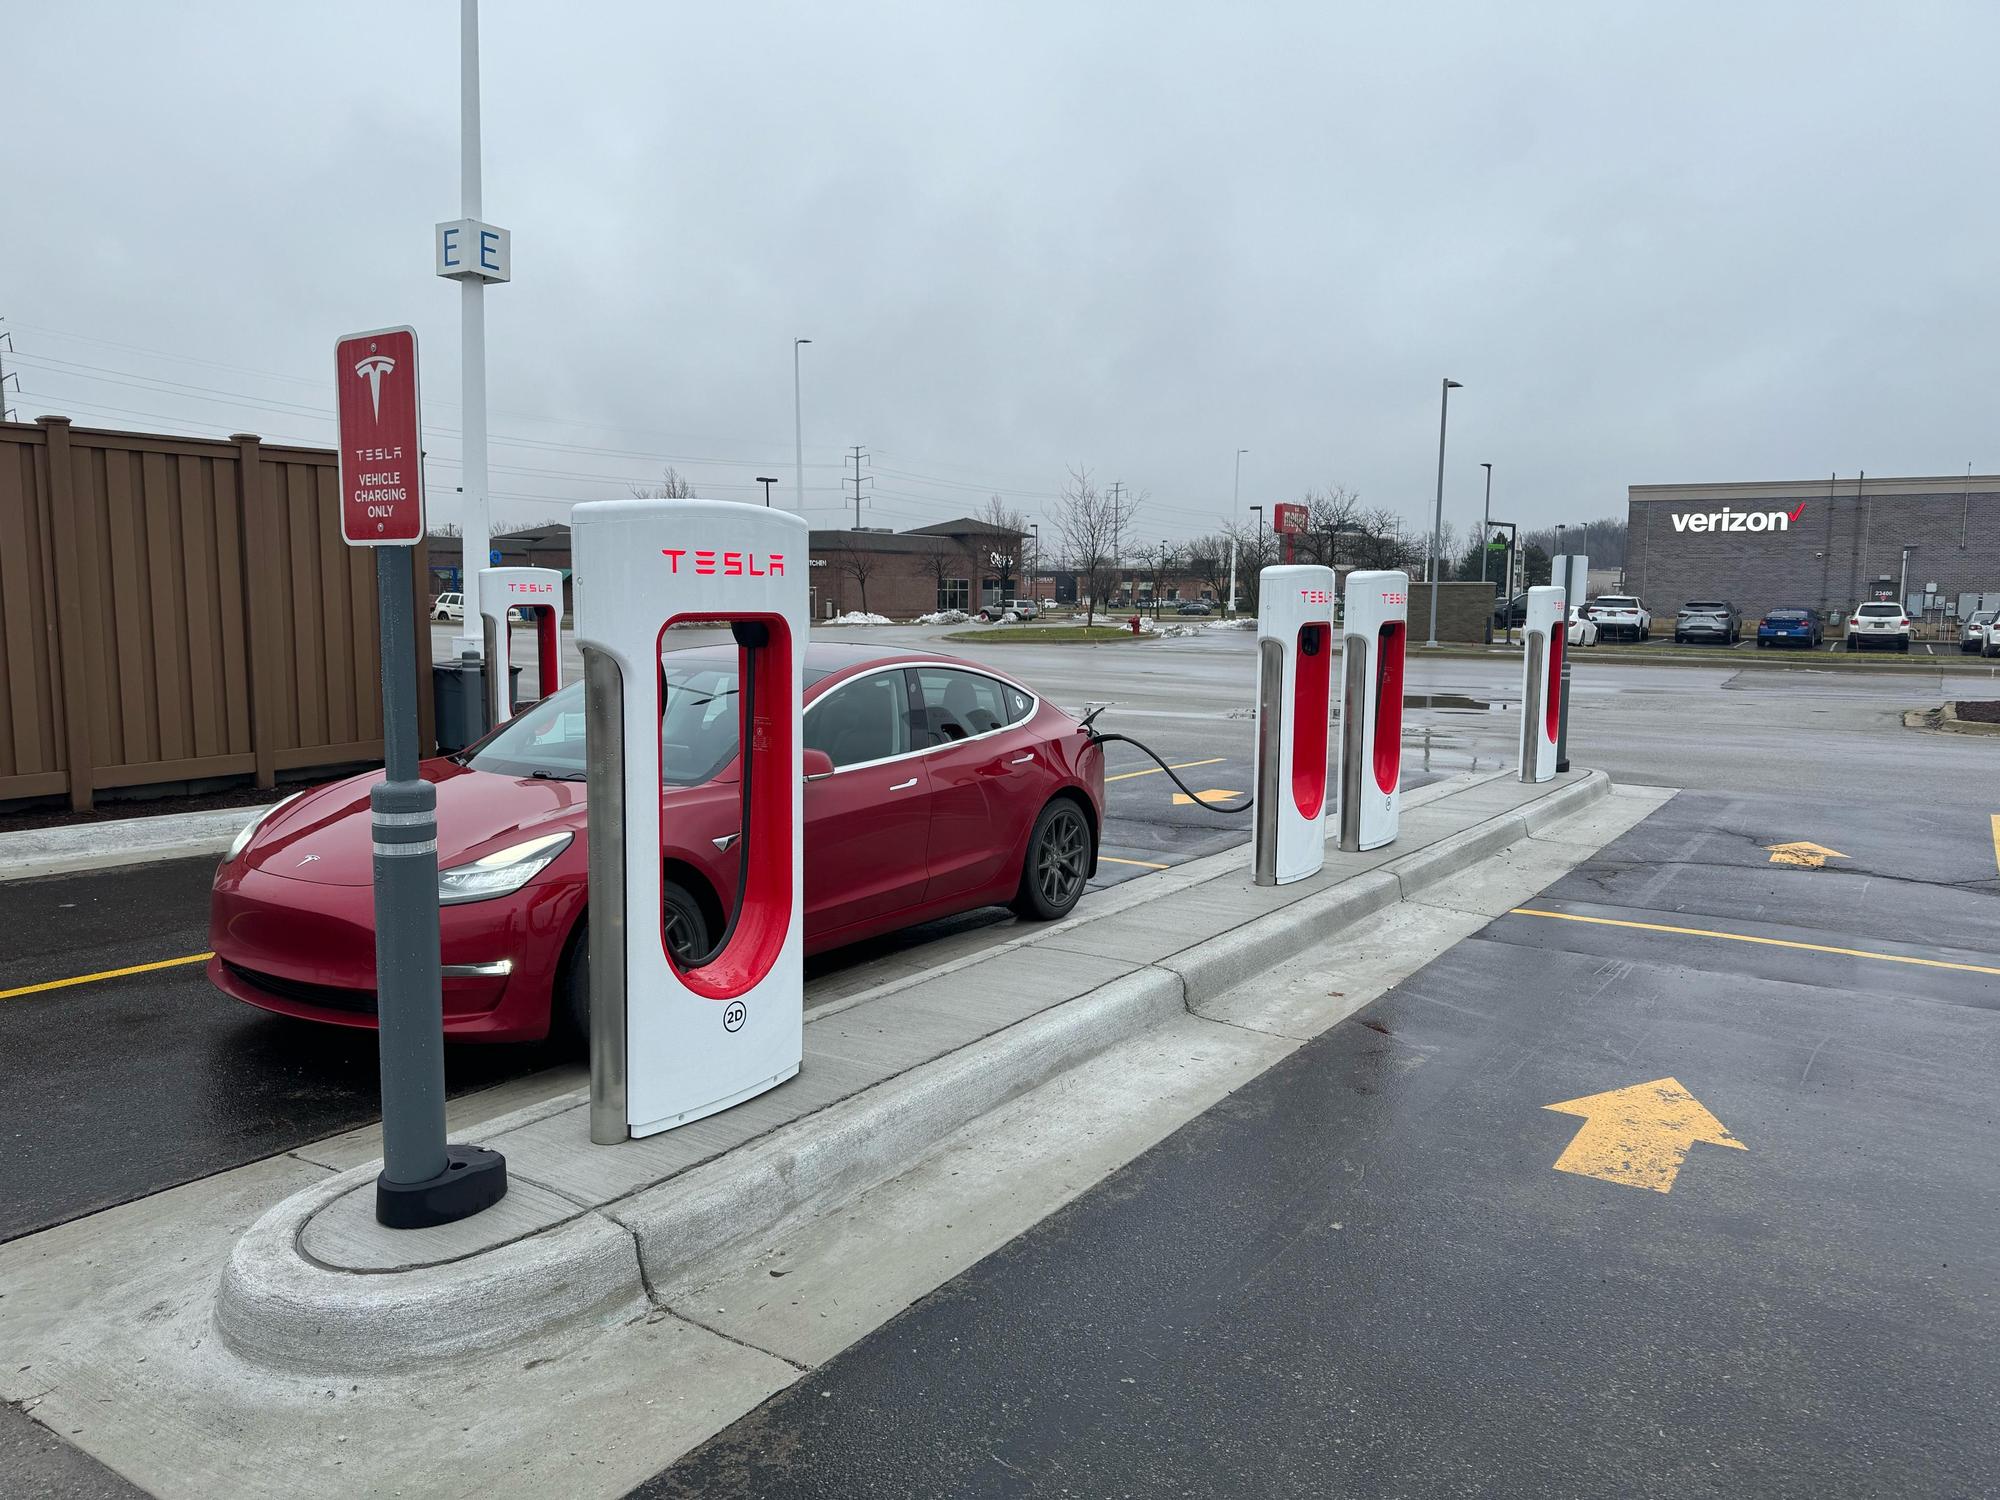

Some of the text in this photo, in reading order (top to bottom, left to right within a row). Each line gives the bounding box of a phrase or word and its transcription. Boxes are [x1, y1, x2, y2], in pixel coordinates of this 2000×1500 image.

[443, 228, 460, 267] E
[480, 230, 500, 271] E
[355, 446, 402, 461] TESLA
[358, 471, 401, 486] VEHICLE
[354, 488, 407, 503] CHARGING
[367, 504, 394, 518] ONLY
[1671, 507, 1788, 533] verizon
[661, 549, 784, 577] TESLA
[508, 583, 553, 593] TESLA
[727, 1009, 743, 1024] 2D
